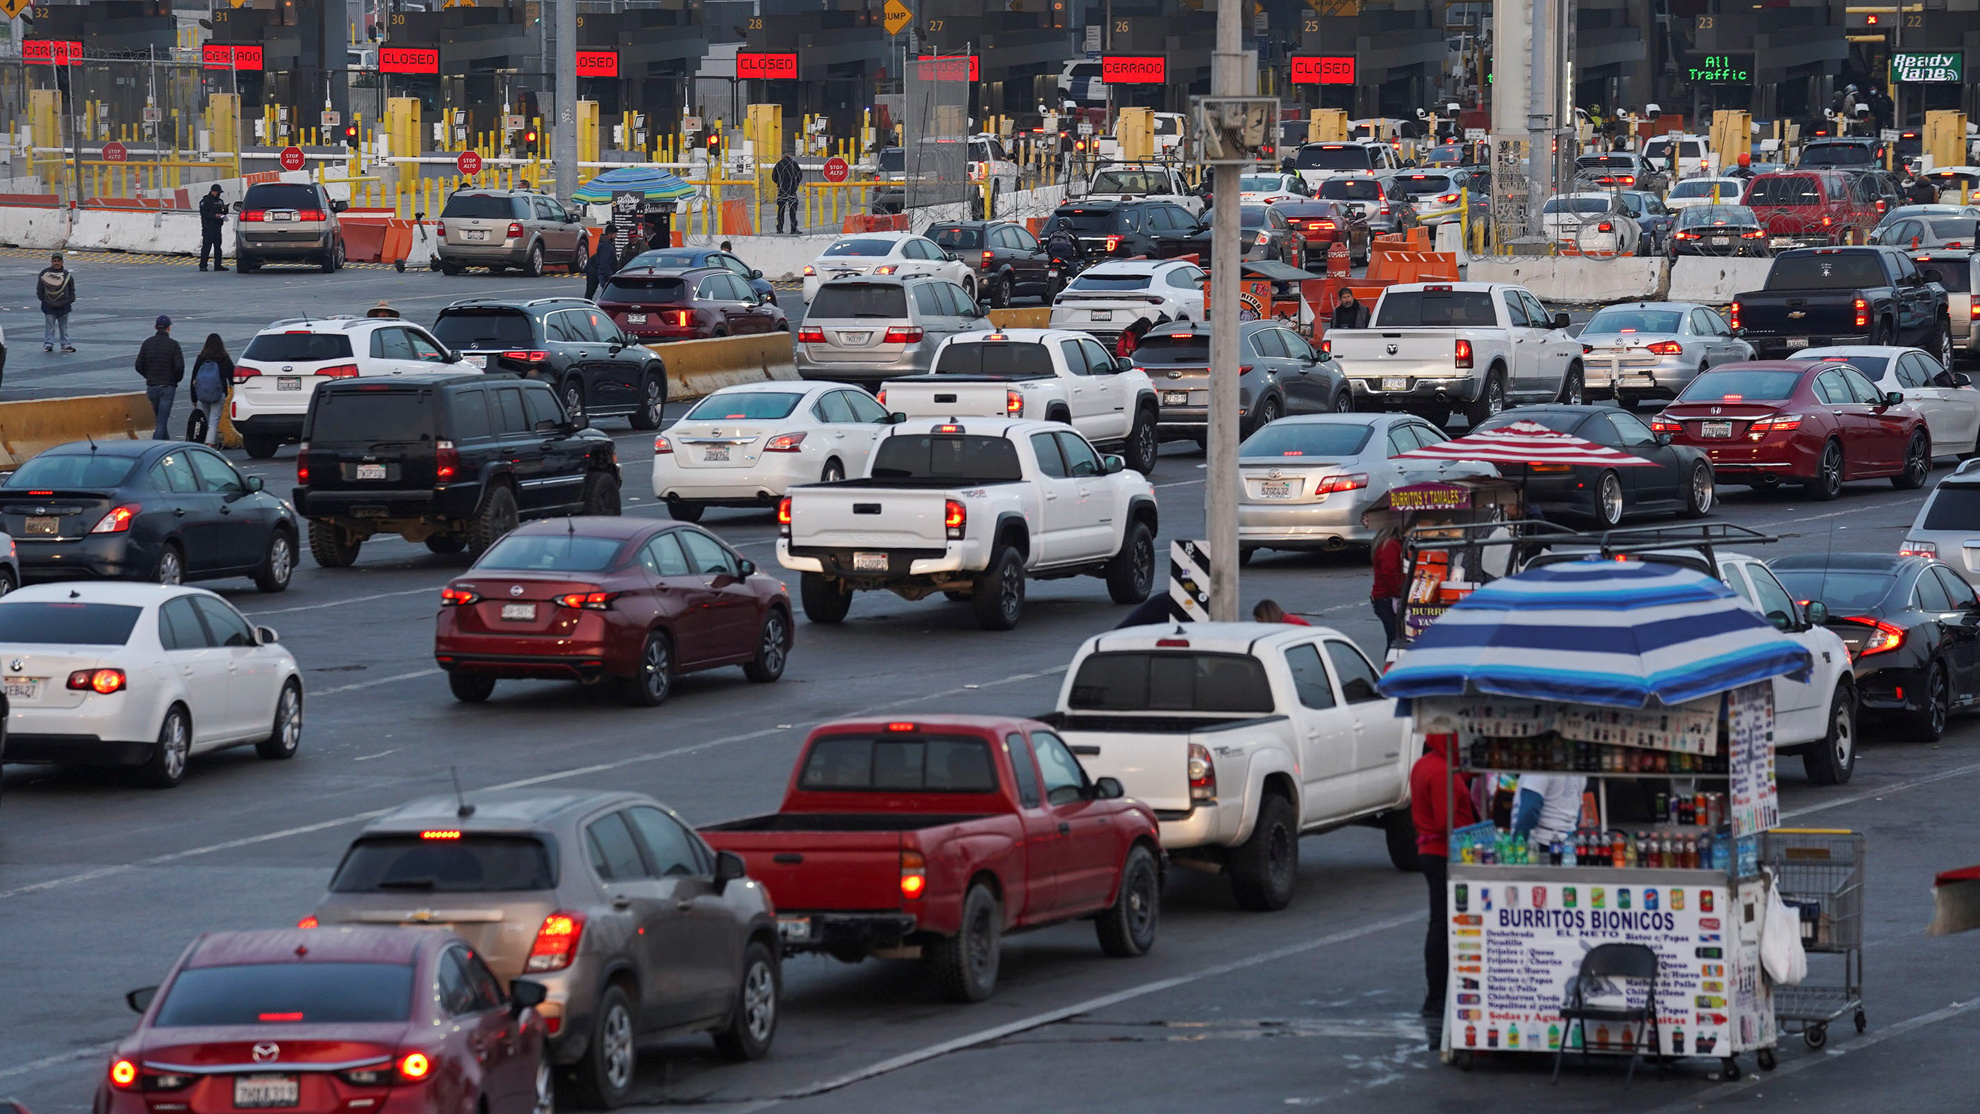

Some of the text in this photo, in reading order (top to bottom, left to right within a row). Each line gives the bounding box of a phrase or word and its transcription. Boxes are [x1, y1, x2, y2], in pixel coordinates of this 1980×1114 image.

[35, 8, 49, 19] 32
[215, 12, 228, 22] 31
[391, 14, 405, 25] 30
[749, 19, 762, 29] 28
[930, 20, 944, 31] 27
[1115, 21, 1129, 32] 26
[1305, 20, 1319, 32] 25
[1699, 17, 1713, 29] 23
[1907, 16, 1922, 28] 22
[24, 46, 80, 57] CERADO
[383, 53, 435, 65] CLOSED
[576, 57, 614, 68] OSED
[740, 58, 793, 70] CLOSED
[1705, 56, 1729, 68] All
[1893, 53, 1954, 72] Ready
[1104, 63, 1162, 74] CERRADO
[1295, 62, 1351, 74] CLOSED
[1689, 68, 1747, 81] Traffic
[1901, 67, 1948, 82] Lane
[1390, 489, 1459, 506] BURRITOS Y TAMALES
[1499, 908, 1674, 931] BURRITOS BIONICOS
[1580, 930, 1619, 938] NETO
[1489, 1011, 1520, 1020] Sodas
[1524, 1014, 1530, 1023] y
